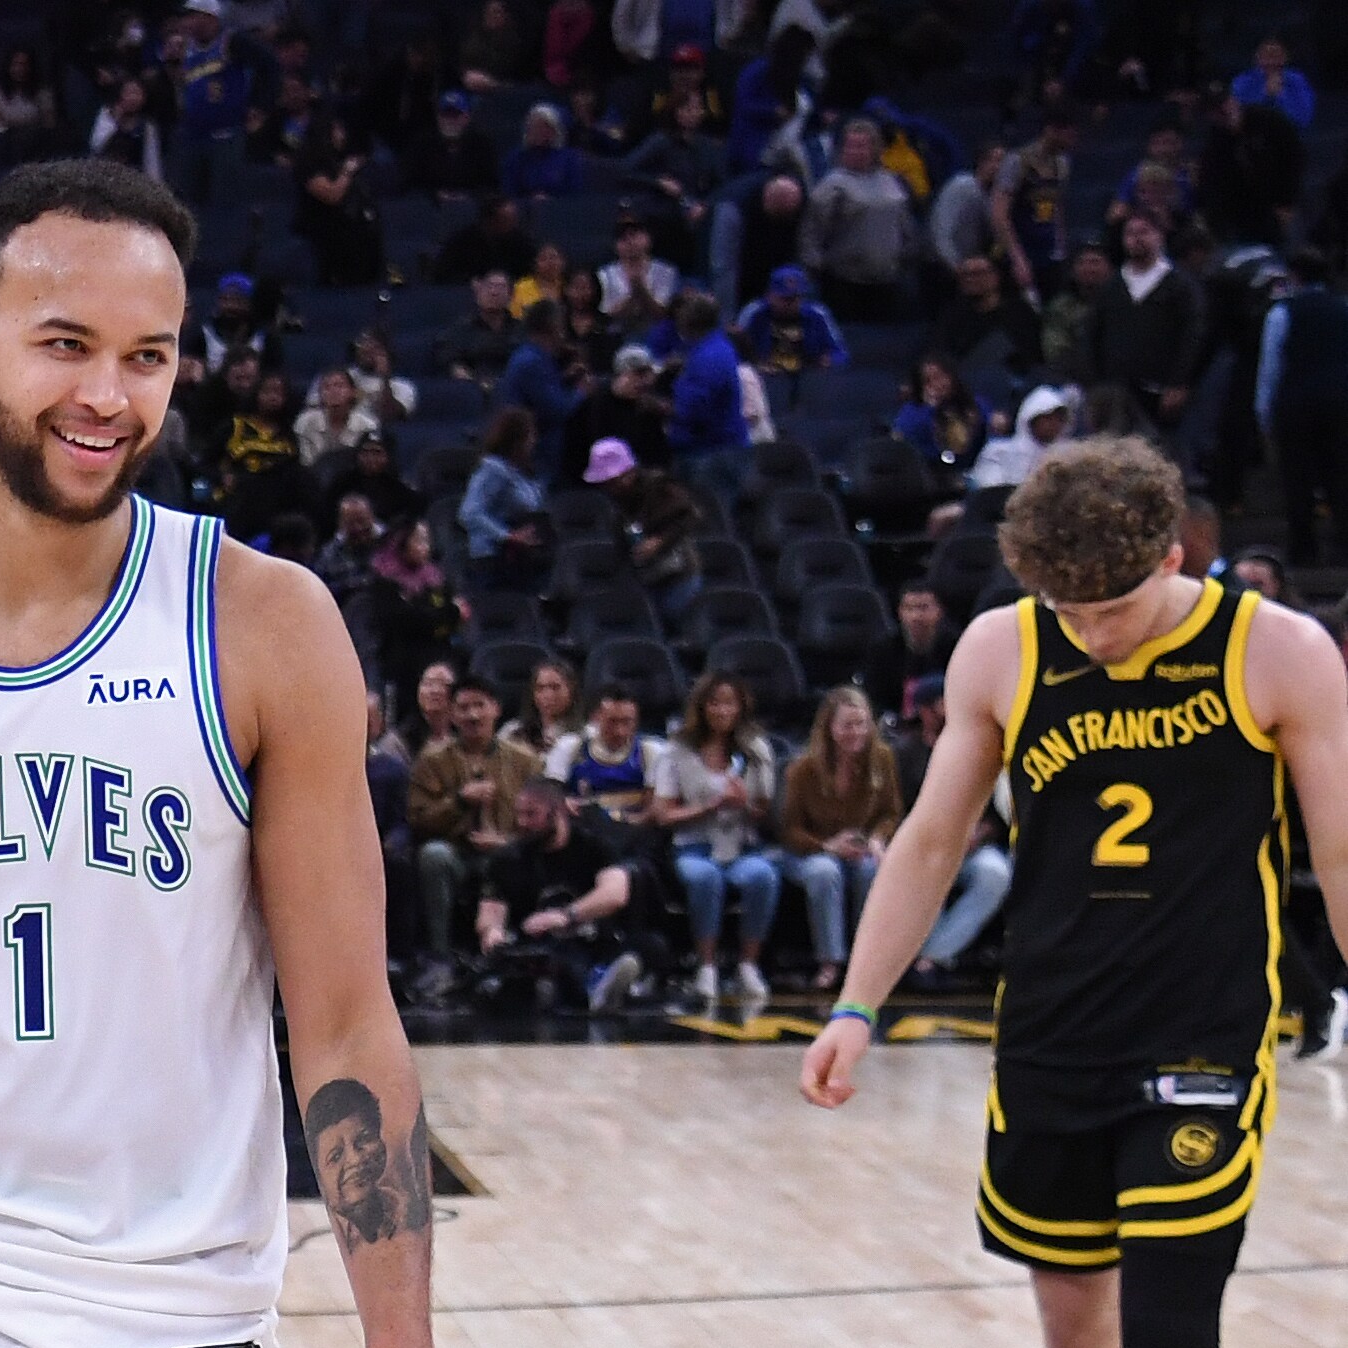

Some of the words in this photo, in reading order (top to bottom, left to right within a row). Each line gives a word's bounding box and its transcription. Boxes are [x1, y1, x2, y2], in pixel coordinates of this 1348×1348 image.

[1022, 726, 1078, 793] SAN
[1066, 689, 1229, 755] FRANCISCO
[1090, 782, 1154, 868] 2
[3, 902, 55, 1042] 1
